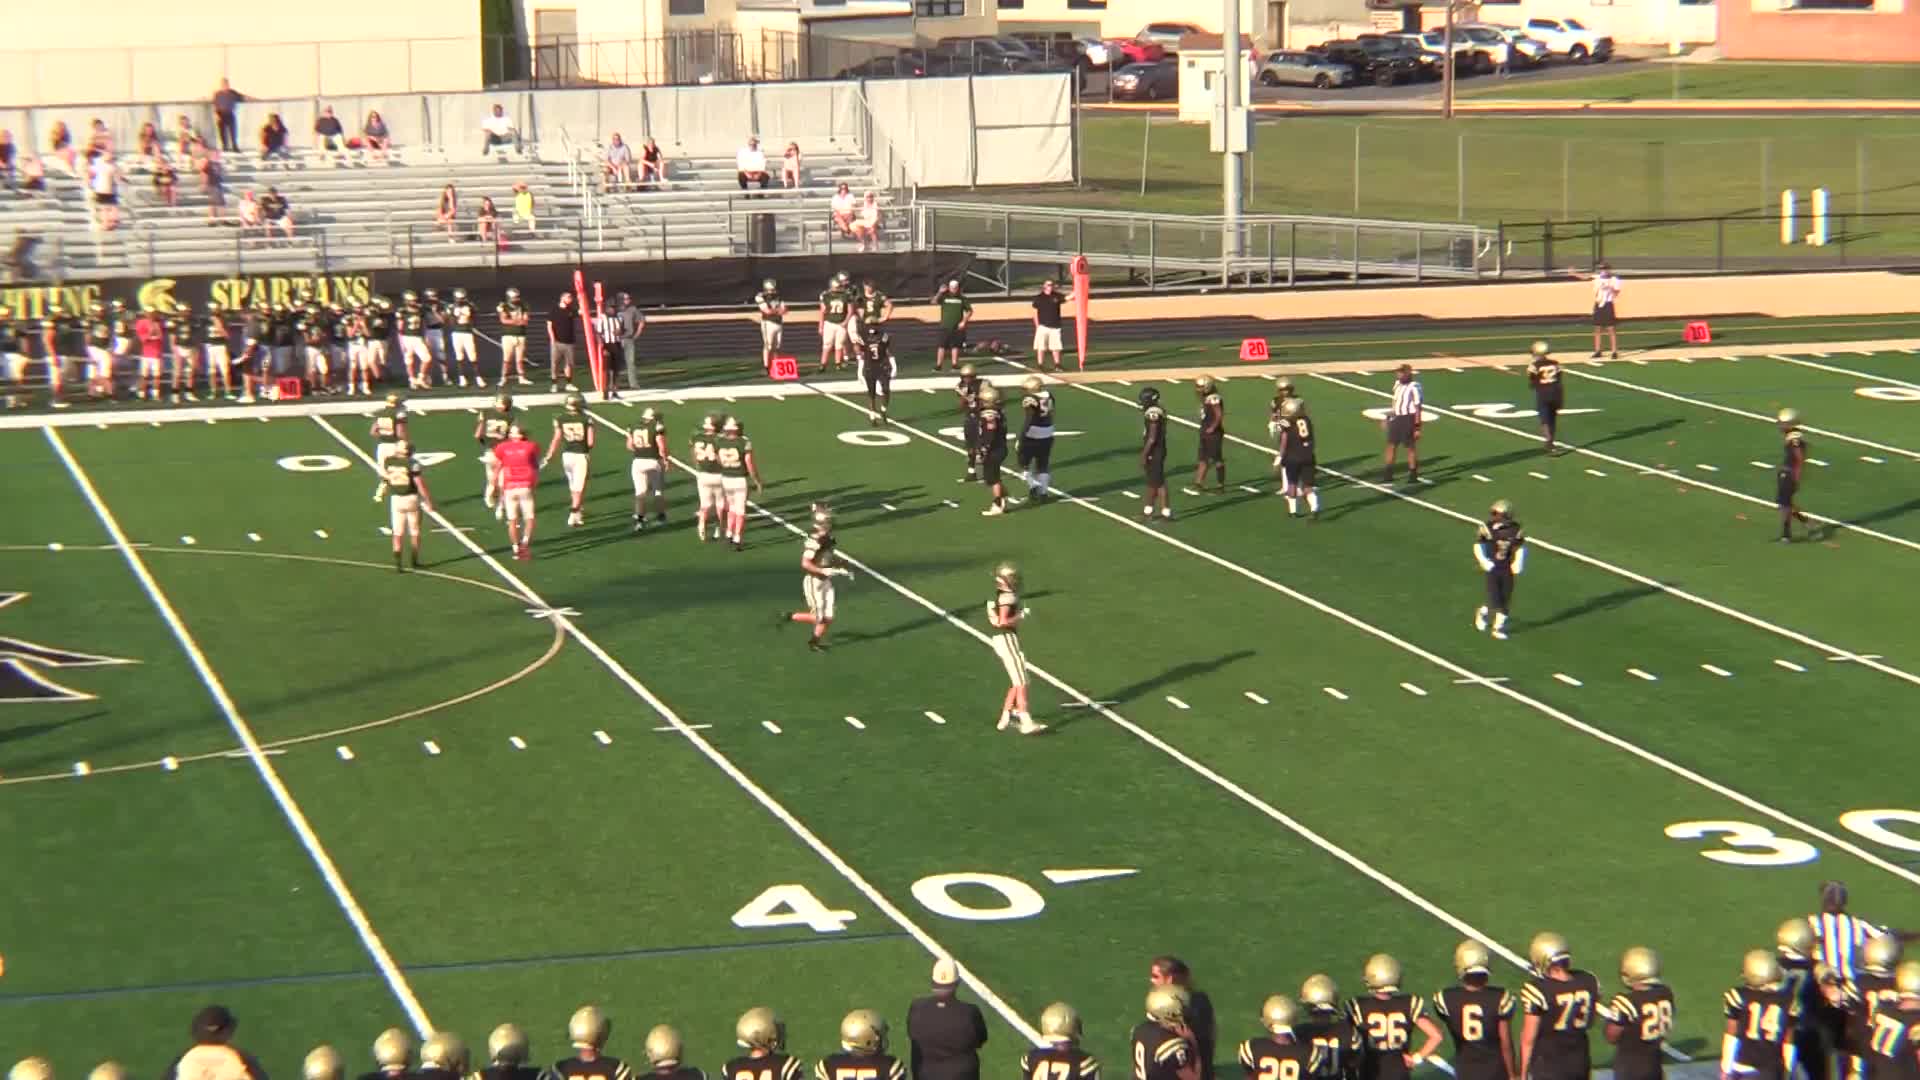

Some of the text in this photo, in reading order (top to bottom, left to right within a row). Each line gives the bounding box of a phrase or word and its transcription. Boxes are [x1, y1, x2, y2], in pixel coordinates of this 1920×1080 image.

[1248, 342, 1264, 356] 20
[776, 362, 794, 376] 30
[1296, 417, 1308, 438] 8
[1462, 1004, 1484, 1041] 6
[1554, 991, 1591, 1030] 73
[1641, 1001, 1672, 1040] 28
[1745, 1001, 1782, 1041] 14
[1367, 1012, 1408, 1050] 26
